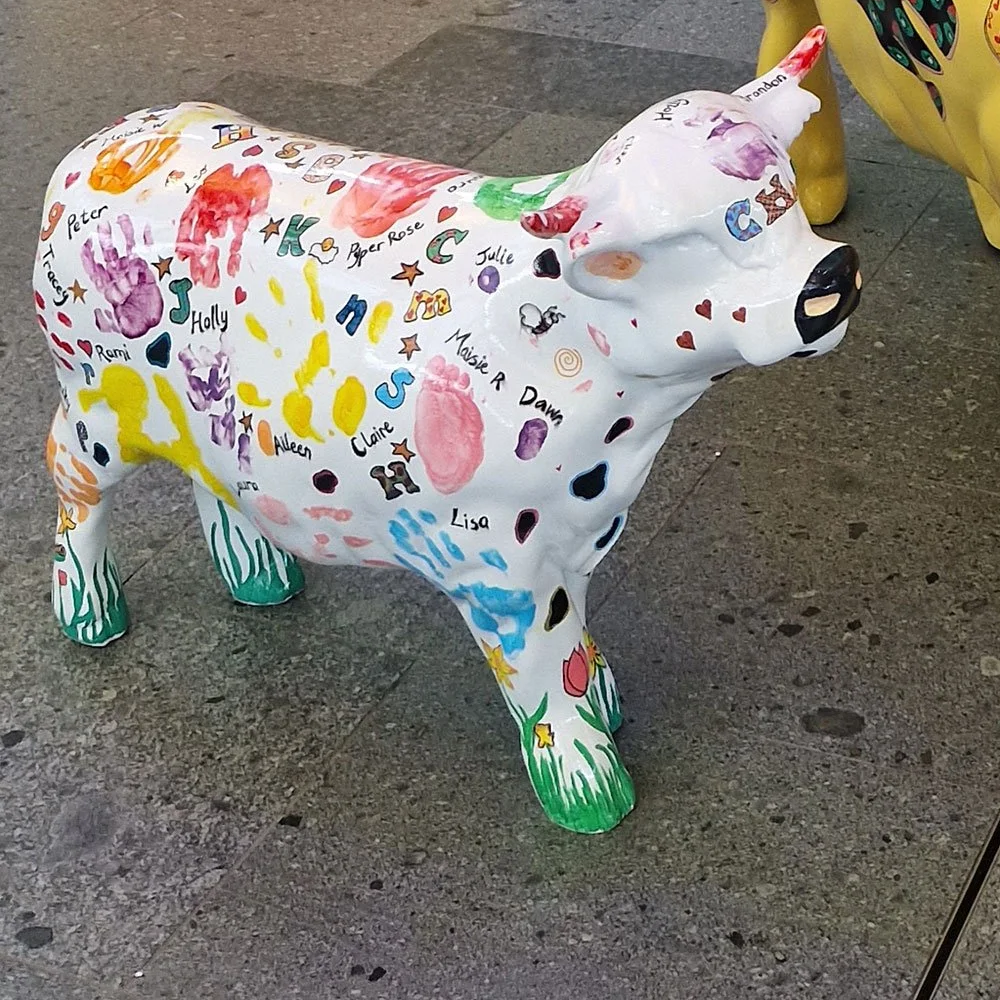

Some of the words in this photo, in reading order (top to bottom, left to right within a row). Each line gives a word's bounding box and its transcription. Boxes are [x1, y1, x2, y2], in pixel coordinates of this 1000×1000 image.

[67, 204, 109, 240] Peter
[276, 213, 321, 258] K
[387, 221, 425, 247] Rose
[725, 197, 763, 242] C
[425, 227, 470, 265] C
[475, 247, 515, 267] Julie
[42, 243, 70, 307] Tracey
[168, 277, 193, 325] J
[190, 303, 229, 335] Holly
[95, 343, 132, 363] Rami
[444, 328, 489, 375] Maisie
[489, 371, 508, 392] R
[374, 366, 416, 410] S
[518, 385, 566, 427] Dawn
[350, 420, 395, 458] Claire
[369, 460, 421, 501] H
[451, 507, 490, 530] Lisa
